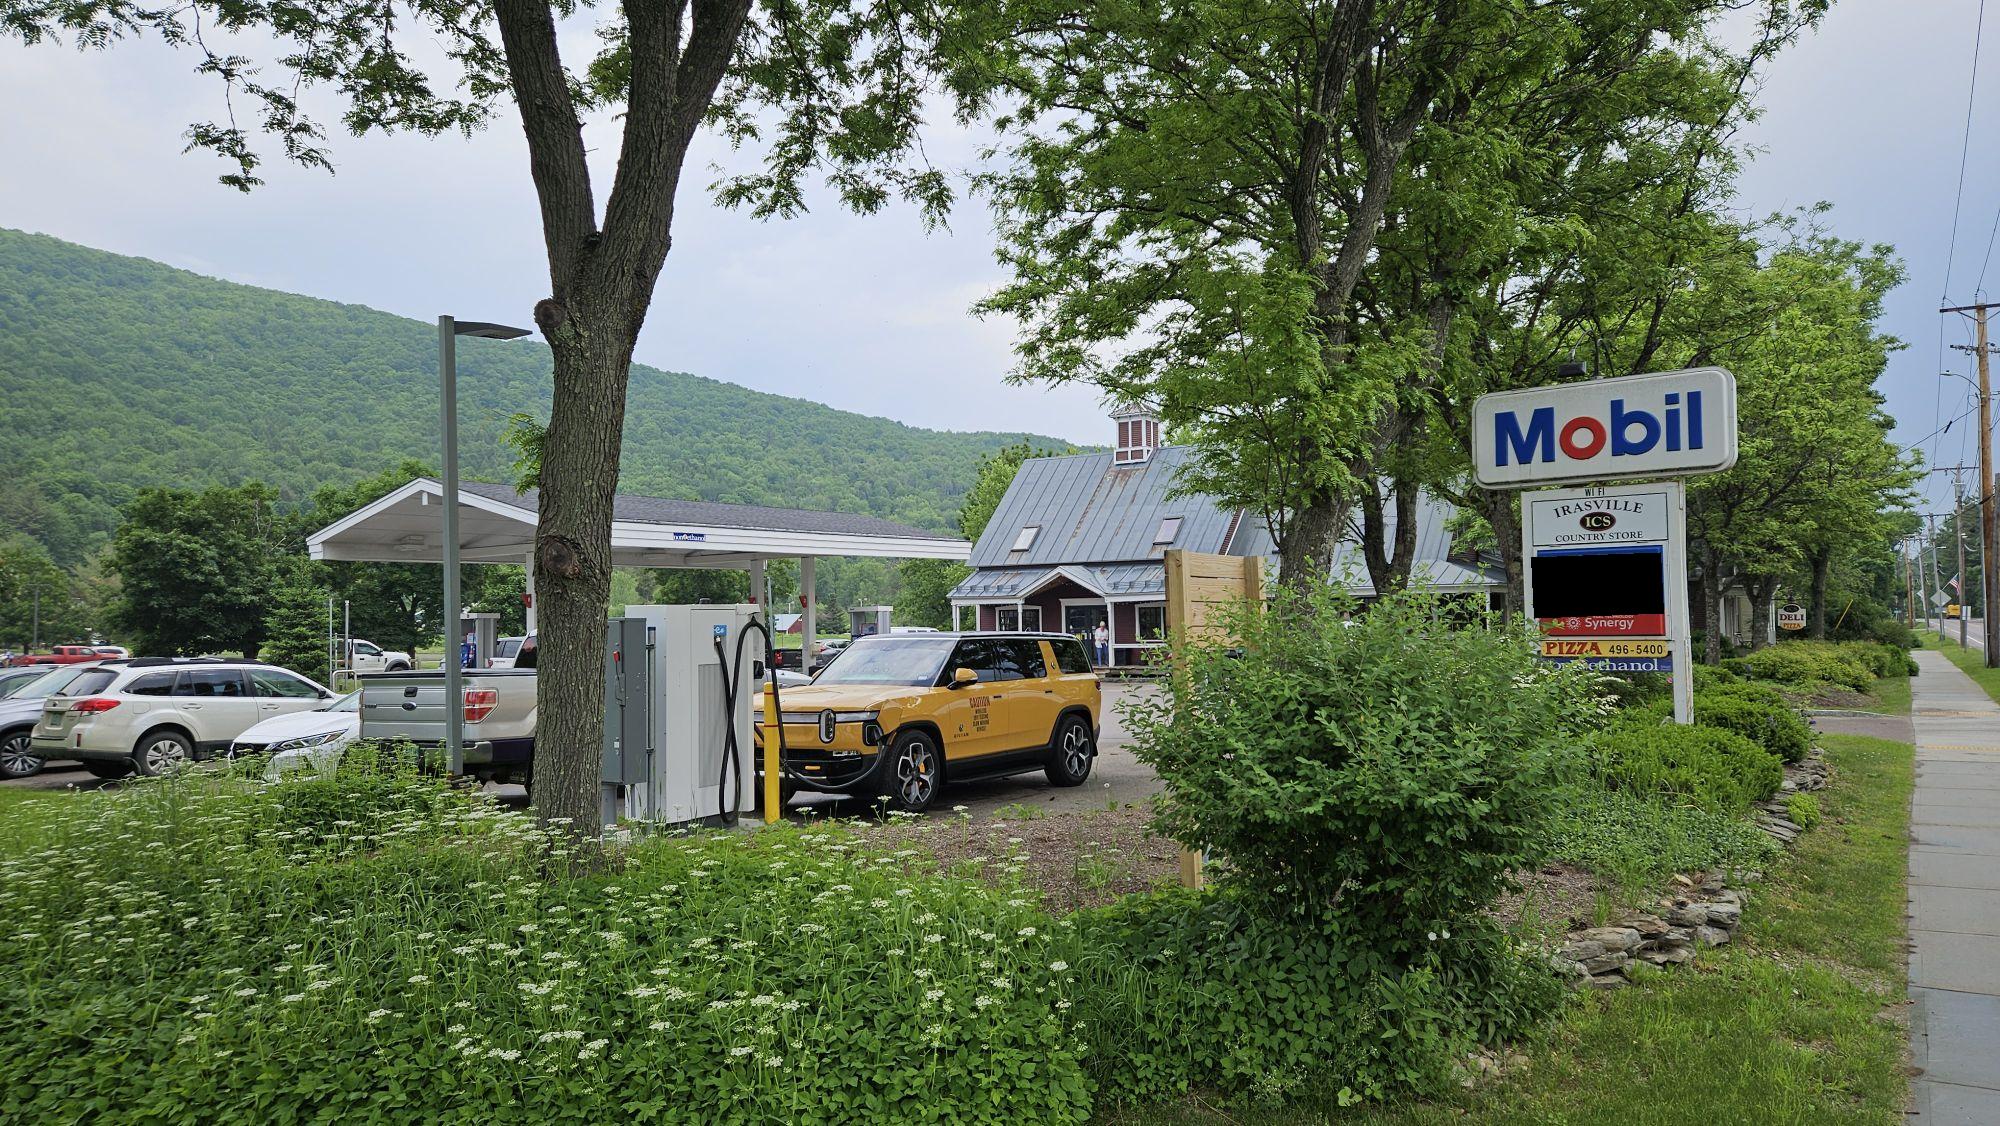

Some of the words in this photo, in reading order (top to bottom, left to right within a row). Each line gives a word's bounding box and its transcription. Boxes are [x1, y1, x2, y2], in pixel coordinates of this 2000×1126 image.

[1494, 391, 1703, 467] Mobil
[1585, 488, 1595, 496] WI
[1598, 487, 1605, 496] FI
[1553, 500, 1644, 518] IRASVILLE
[1584, 516, 1611, 528] ICS
[1555, 533, 1606, 543] COUNTRY
[1609, 531, 1643, 540] STORE
[1585, 617, 1634, 630] Synergy
[1545, 641, 1602, 655] PIZZA
